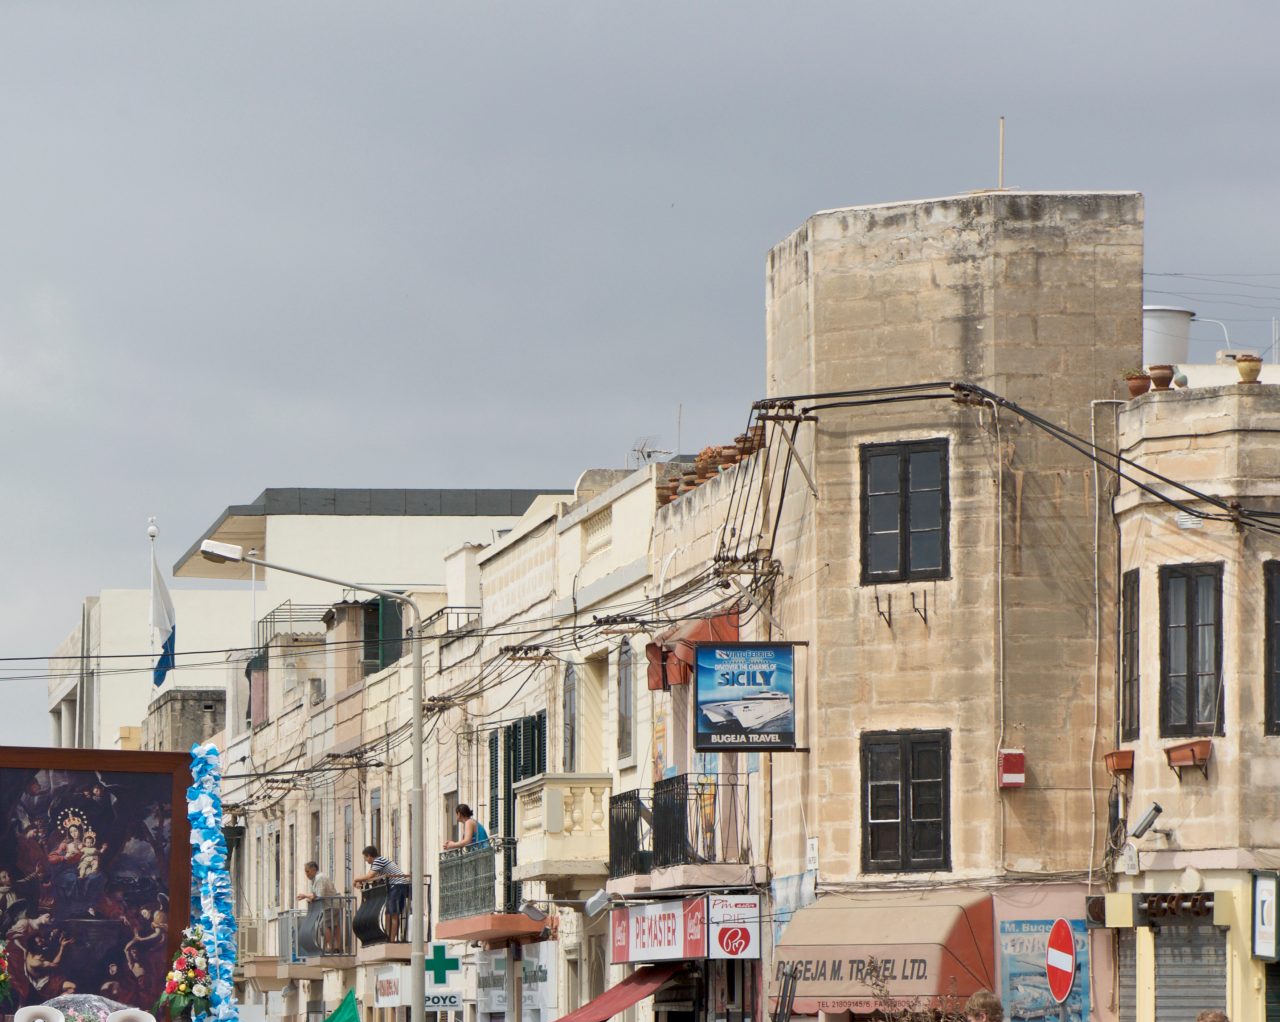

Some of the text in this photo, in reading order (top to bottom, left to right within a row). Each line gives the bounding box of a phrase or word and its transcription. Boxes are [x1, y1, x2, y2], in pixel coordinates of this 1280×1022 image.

[718, 670, 775, 686] SICILY
[711, 734, 780, 743] BUGEJA TRAVEL
[636, 912, 677, 949] PIE MASTER
[1006, 924, 1019, 932] M.
[830, 960, 843, 982] M.
[901, 958, 928, 980] LTD.
[425, 995, 457, 1004] POYC
